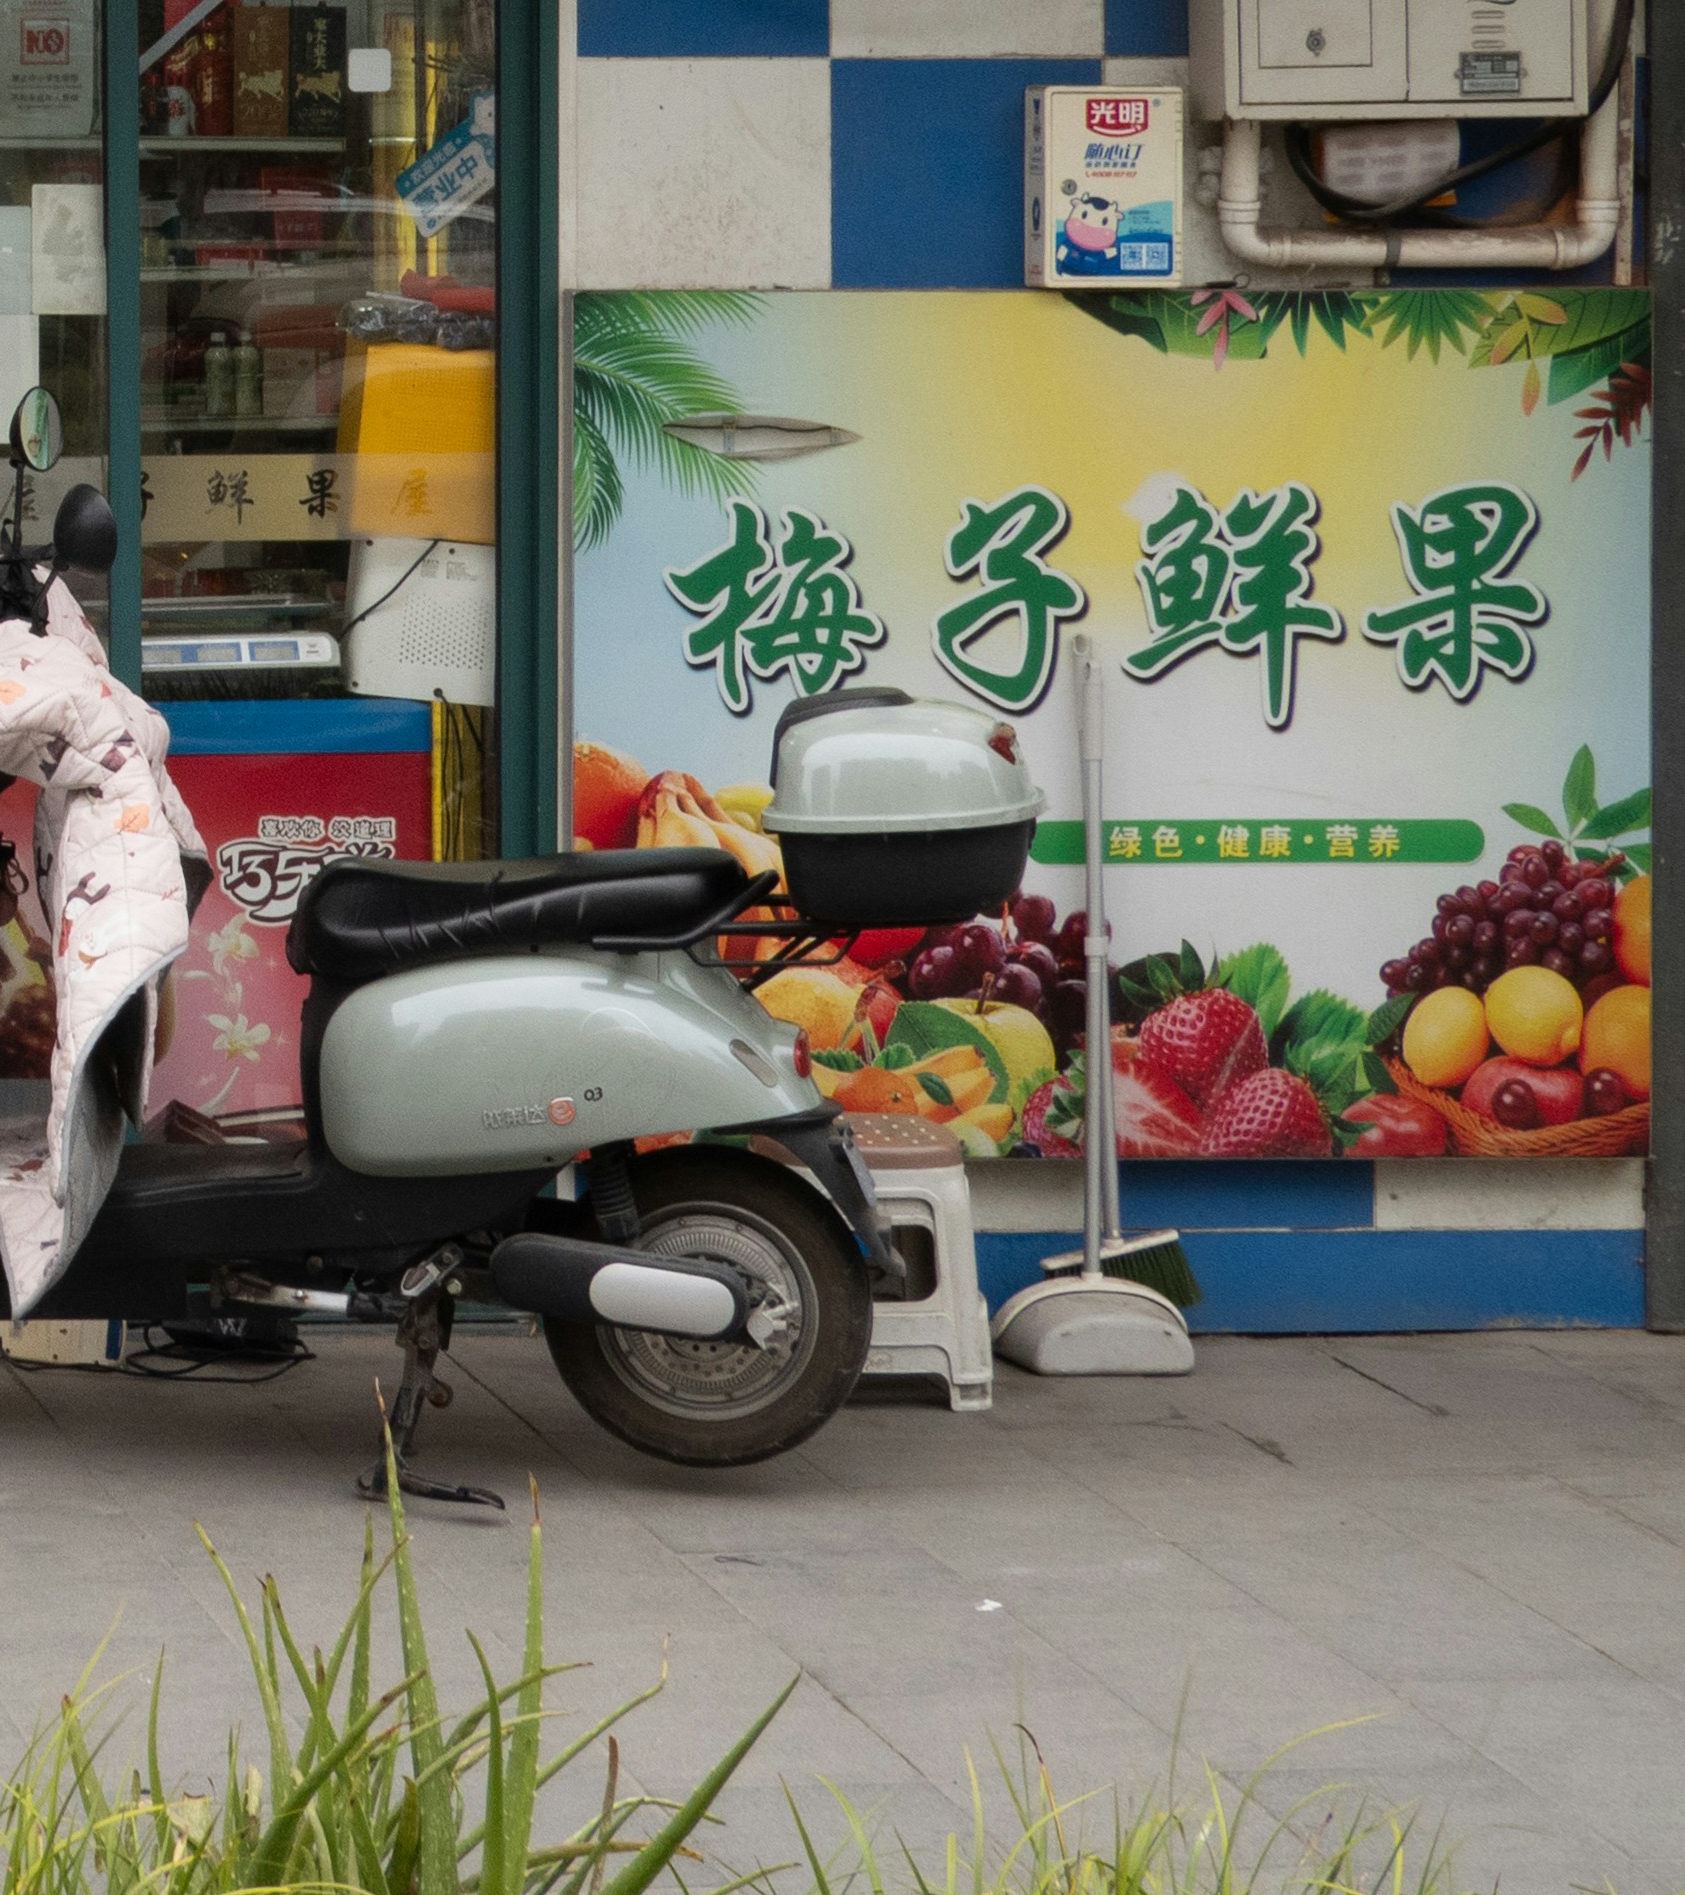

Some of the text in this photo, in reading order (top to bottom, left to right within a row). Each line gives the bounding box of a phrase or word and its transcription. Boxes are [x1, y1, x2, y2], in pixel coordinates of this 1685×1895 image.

[1090, 102, 1146, 124] 光明
[664, 480, 1549, 729] 梅子鲜果
